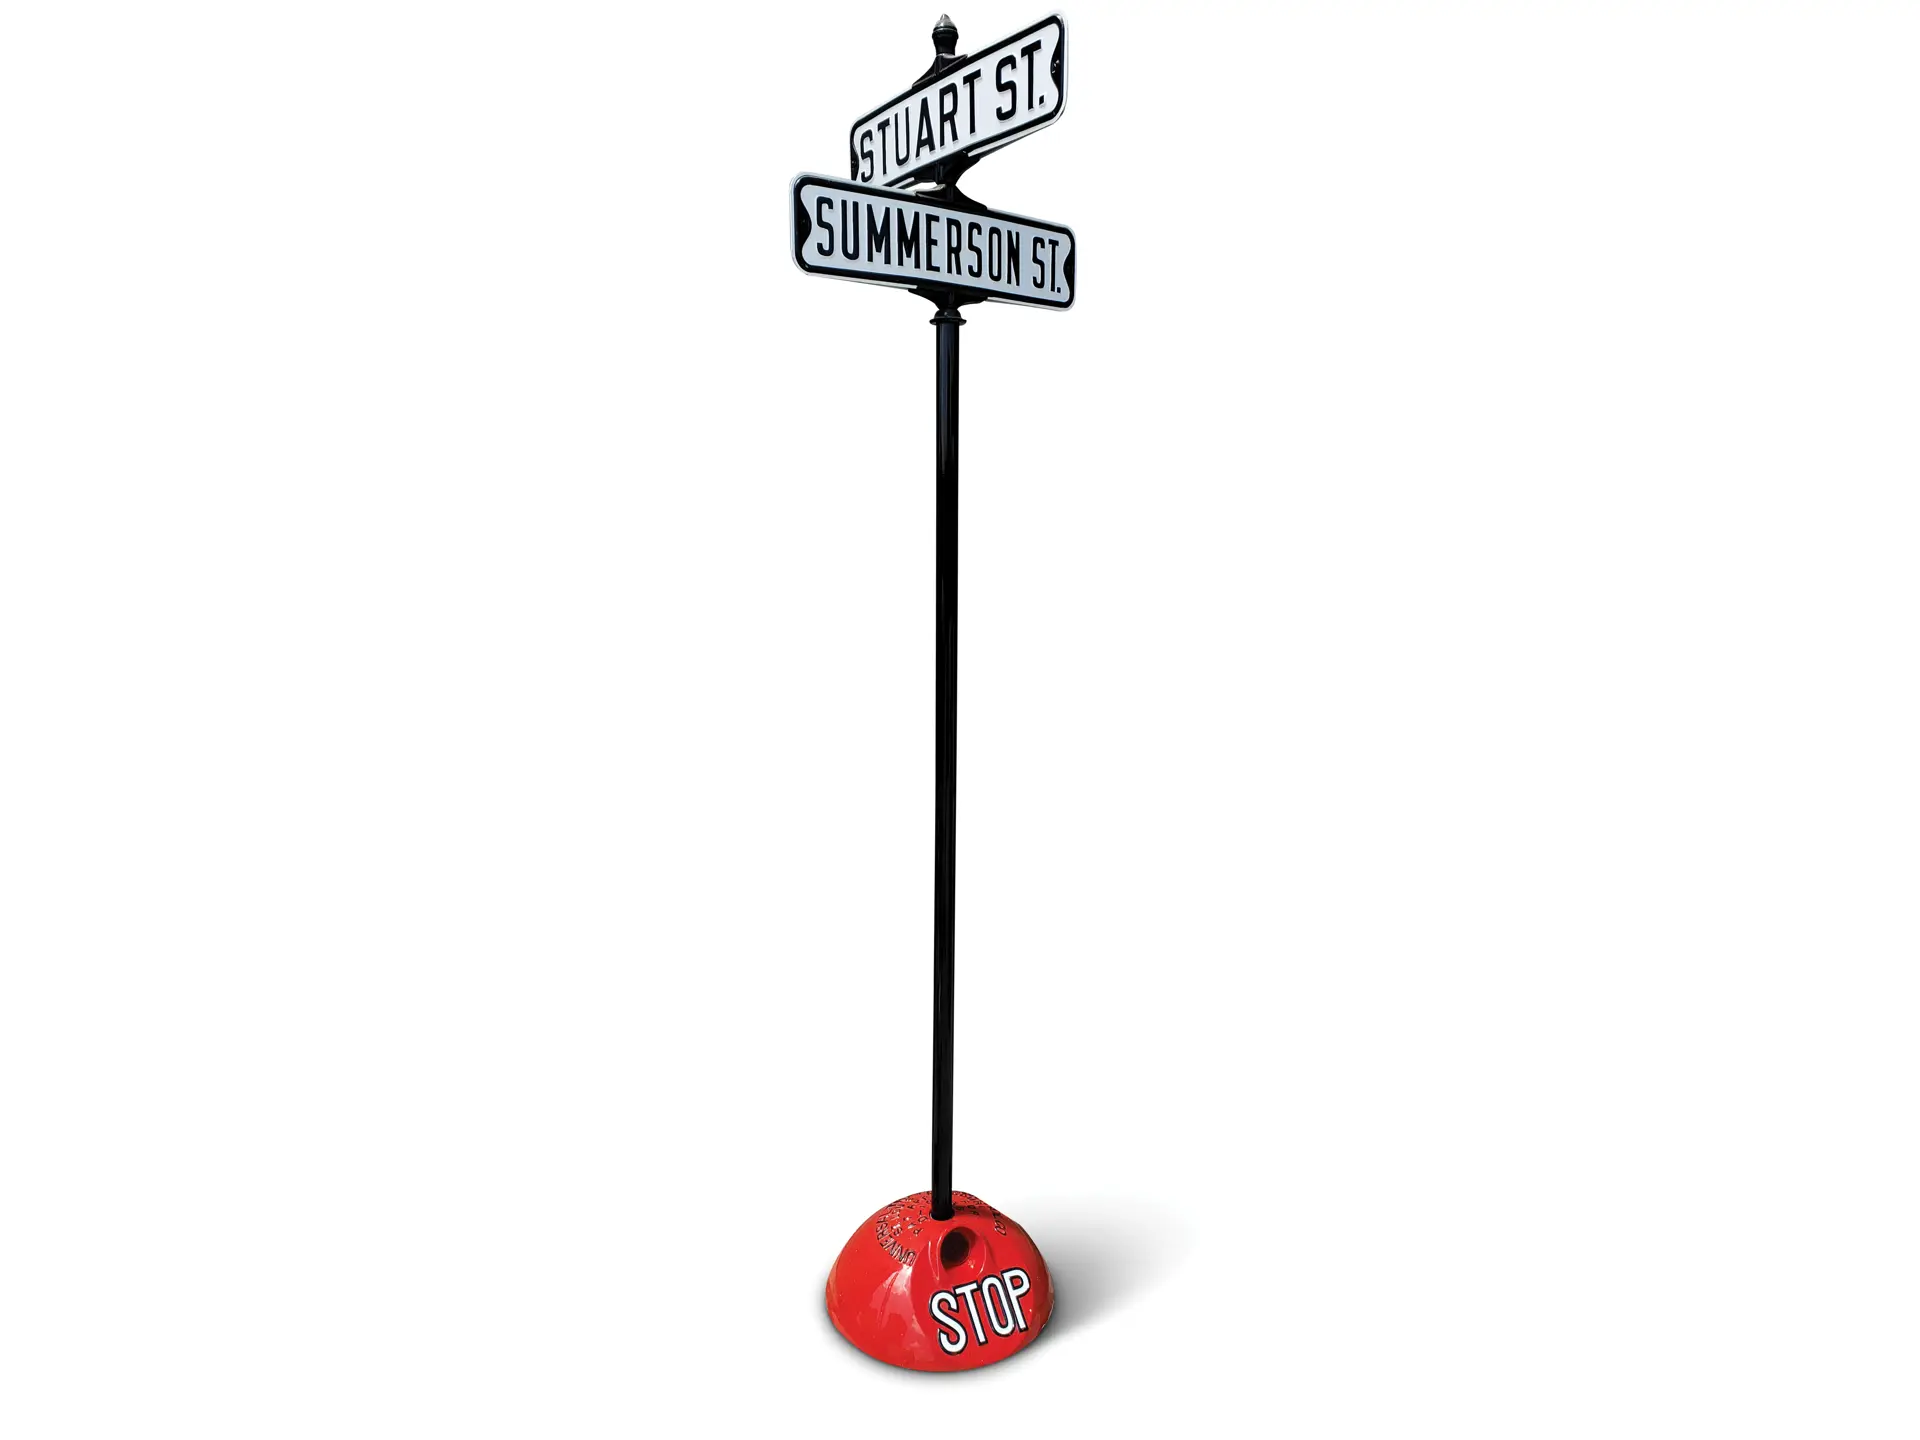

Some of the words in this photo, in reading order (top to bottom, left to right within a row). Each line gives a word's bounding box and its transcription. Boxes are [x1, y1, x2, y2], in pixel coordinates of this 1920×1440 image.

[860, 67, 981, 183] STUART
[995, 39, 1045, 121] ST.
[816, 196, 1021, 287] SUMMERSON
[1031, 236, 1062, 294] ST.
[929, 1267, 1031, 1355] STOP
